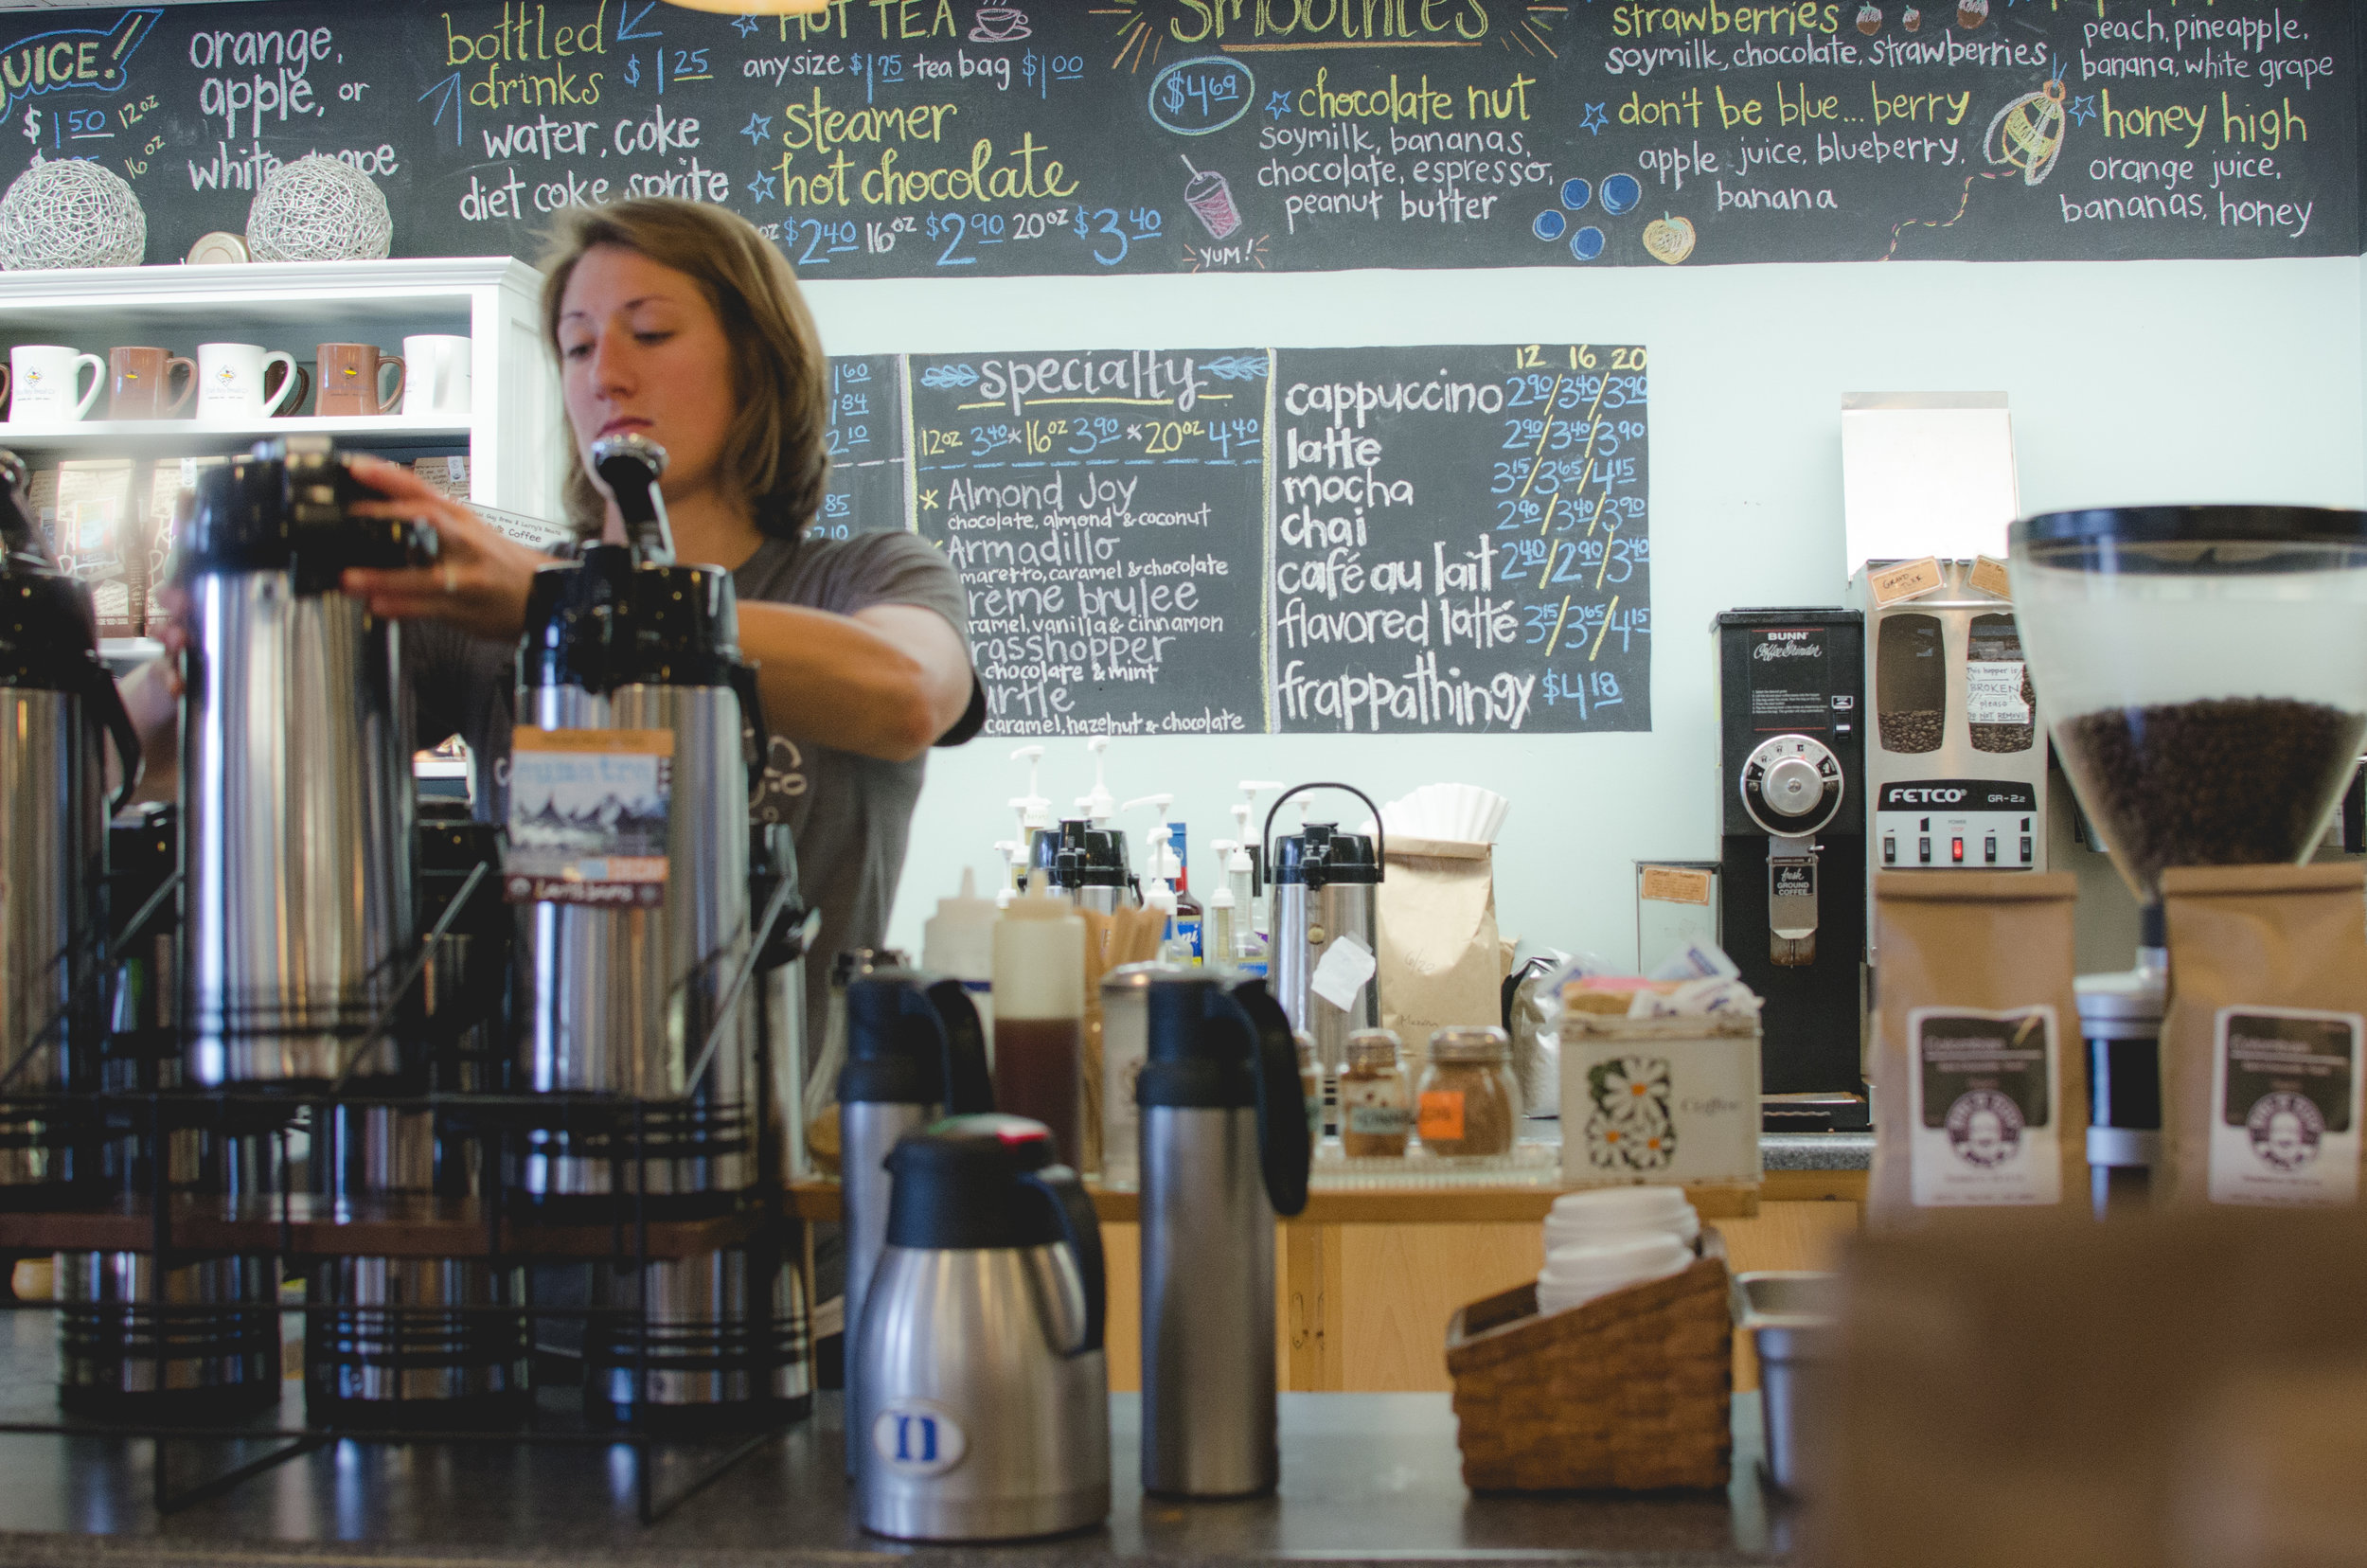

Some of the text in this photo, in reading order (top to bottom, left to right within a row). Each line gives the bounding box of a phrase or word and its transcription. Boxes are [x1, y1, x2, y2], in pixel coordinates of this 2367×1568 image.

[442, 0, 607, 66] bottled
[779, 0, 956, 42] HOT TEA
[1612, 0, 1841, 38] strawberries
[2083, 9, 2169, 48] peach,
[2175, 13, 2308, 53] pineapple,
[0, 15, 142, 108] UICE!
[189, 27, 342, 81] orange,
[913, 53, 952, 80] tea
[958, 49, 1010, 90] bag
[1605, 29, 2048, 76] soymilk, chocolate, strawberries
[2080, 47, 2333, 90] banana, white grape
[200, 68, 369, 138] apple, or
[470, 62, 603, 109] drinks
[1298, 67, 1452, 123] chocolate
[1468, 73, 1537, 120] nut
[1618, 86, 1702, 128] don't
[1716, 84, 1761, 129] be
[1872, 80, 1970, 126] berry
[484, 104, 701, 160] water, coke
[1259, 124, 1531, 156] soymilk, bananas,
[2102, 89, 2307, 151] honey high
[301, 144, 400, 177] ape
[772, 132, 1079, 206] hot chocolate
[1258, 155, 1554, 191] chocolate, espresso,
[1639, 132, 1966, 190] apple juice, blueberry,
[2090, 151, 2281, 190] orange juice,
[460, 157, 729, 222] diet coke sprite
[1285, 187, 1498, 234] peanut butter
[1717, 181, 1838, 211] banana
[2060, 191, 2312, 239] bananas, honey
[1201, 238, 1254, 267] YUM!
[1516, 344, 1647, 370] 12 16 20
[980, 349, 1208, 416] specialty
[1285, 368, 1504, 429] cappuccino
[1287, 427, 1382, 470] latte
[948, 472, 1138, 517] Almond Joy
[1282, 467, 1414, 508] mocha
[508, 528, 542, 543] Coffee
[948, 504, 1213, 532] chocolate, almond & coconut
[1281, 504, 1367, 547] chai
[947, 527, 1120, 569] Armadillo
[960, 554, 1229, 584] maretto, caramel & chocolate
[1371, 560, 1422, 595] au
[1433, 533, 1498, 596] lait
[968, 578, 1199, 618] rème brulee
[966, 614, 1223, 636] ramel, vanilla & cinnamon
[1277, 597, 1429, 648] flavored
[1768, 632, 1807, 641] BUNN
[970, 633, 1176, 669] rasshopper
[985, 660, 1159, 685] chocolate & mint
[1753, 643, 1783, 662] Coffee
[1278, 650, 1536, 731] frappathingy
[1970, 683, 2020, 692] BROKEN
[1146, 720, 1159, 734] &
[1162, 706, 1246, 734] chocolate
[1889, 788, 1963, 803] FETCO
